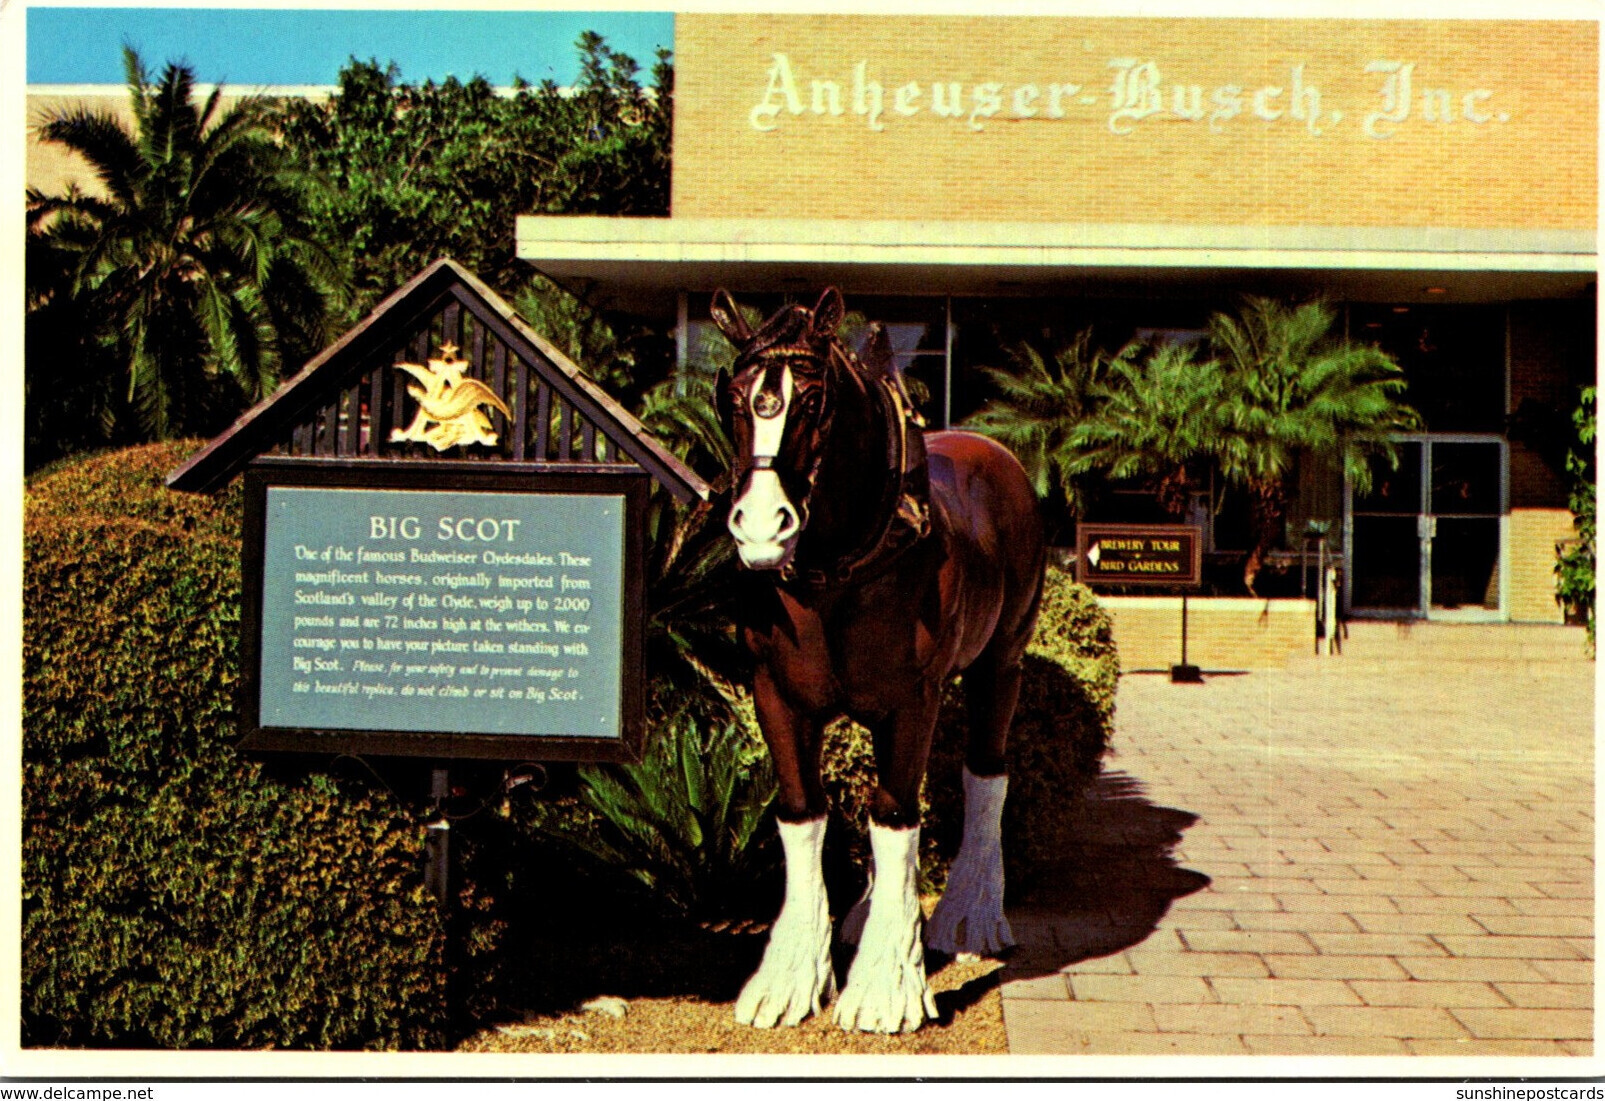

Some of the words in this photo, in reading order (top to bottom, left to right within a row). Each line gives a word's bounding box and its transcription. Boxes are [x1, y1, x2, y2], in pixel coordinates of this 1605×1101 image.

[749, 52, 1343, 136] Anheuser-Busch,
[1362, 58, 1511, 140] Inc.
[369, 516, 421, 540] BIG
[437, 516, 521, 542] SCOT
[294, 545, 318, 561] One
[319, 545, 333, 564] of
[335, 546, 354, 562] the
[357, 545, 406, 565] famous
[410, 547, 477, 564] Budweiser
[559, 551, 592, 567] These
[1100, 540, 1144, 551] BREWERY
[1151, 540, 1181, 552] TOUR
[1127, 560, 1180, 573] GARDENS
[295, 569, 369, 587] magnificent
[432, 572, 492, 590] originally
[498, 575, 554, 591] imported
[561, 574, 592, 594] from
[294, 589, 355, 606] Scotland's
[361, 592, 398, 610] valley
[402, 592, 416, 611] of
[417, 594, 438, 608] the
[479, 595, 513, 613] weigh
[516, 600, 533, 615] up
[535, 596, 549, 611] to
[294, 615, 335, 631] pounds
[339, 615, 360, 628] and
[362, 617, 380, 629] are
[384, 615, 399, 629] 72
[403, 616, 438, 630] inches
[442, 617, 467, 634] high
[470, 619, 482, 632] at
[485, 618, 503, 632] the
[553, 619, 571, 634] We
[293, 637, 337, 652] courage
[340, 639, 361, 653] you
[362, 637, 374, 650] to
[376, 636, 403, 651] have
[404, 640, 430, 655] your
[431, 639, 470, 655] picture
[472, 640, 505, 653] taken
[508, 641, 560, 658] standing
[563, 641, 589, 656] with
[293, 656, 313, 675] Big
[314, 657, 344, 672] Scot.
[388, 660, 404, 678] for
[404, 664, 428, 677] your
[427, 662, 456, 679] safety
[459, 664, 479, 676] and
[480, 664, 491, 676] to
[488, 666, 523, 680] prevent
[526, 665, 565, 681] damage
[567, 667, 580, 679] to
[292, 680, 311, 694] this
[314, 680, 360, 697] beautiful
[400, 684, 416, 697] do
[417, 685, 436, 698] not
[438, 685, 470, 699] climb
[472, 688, 488, 698] or
[489, 686, 506, 700] sit
[508, 690, 524, 700] on
[525, 685, 546, 705] Big
[547, 687, 584, 702] Scot.
